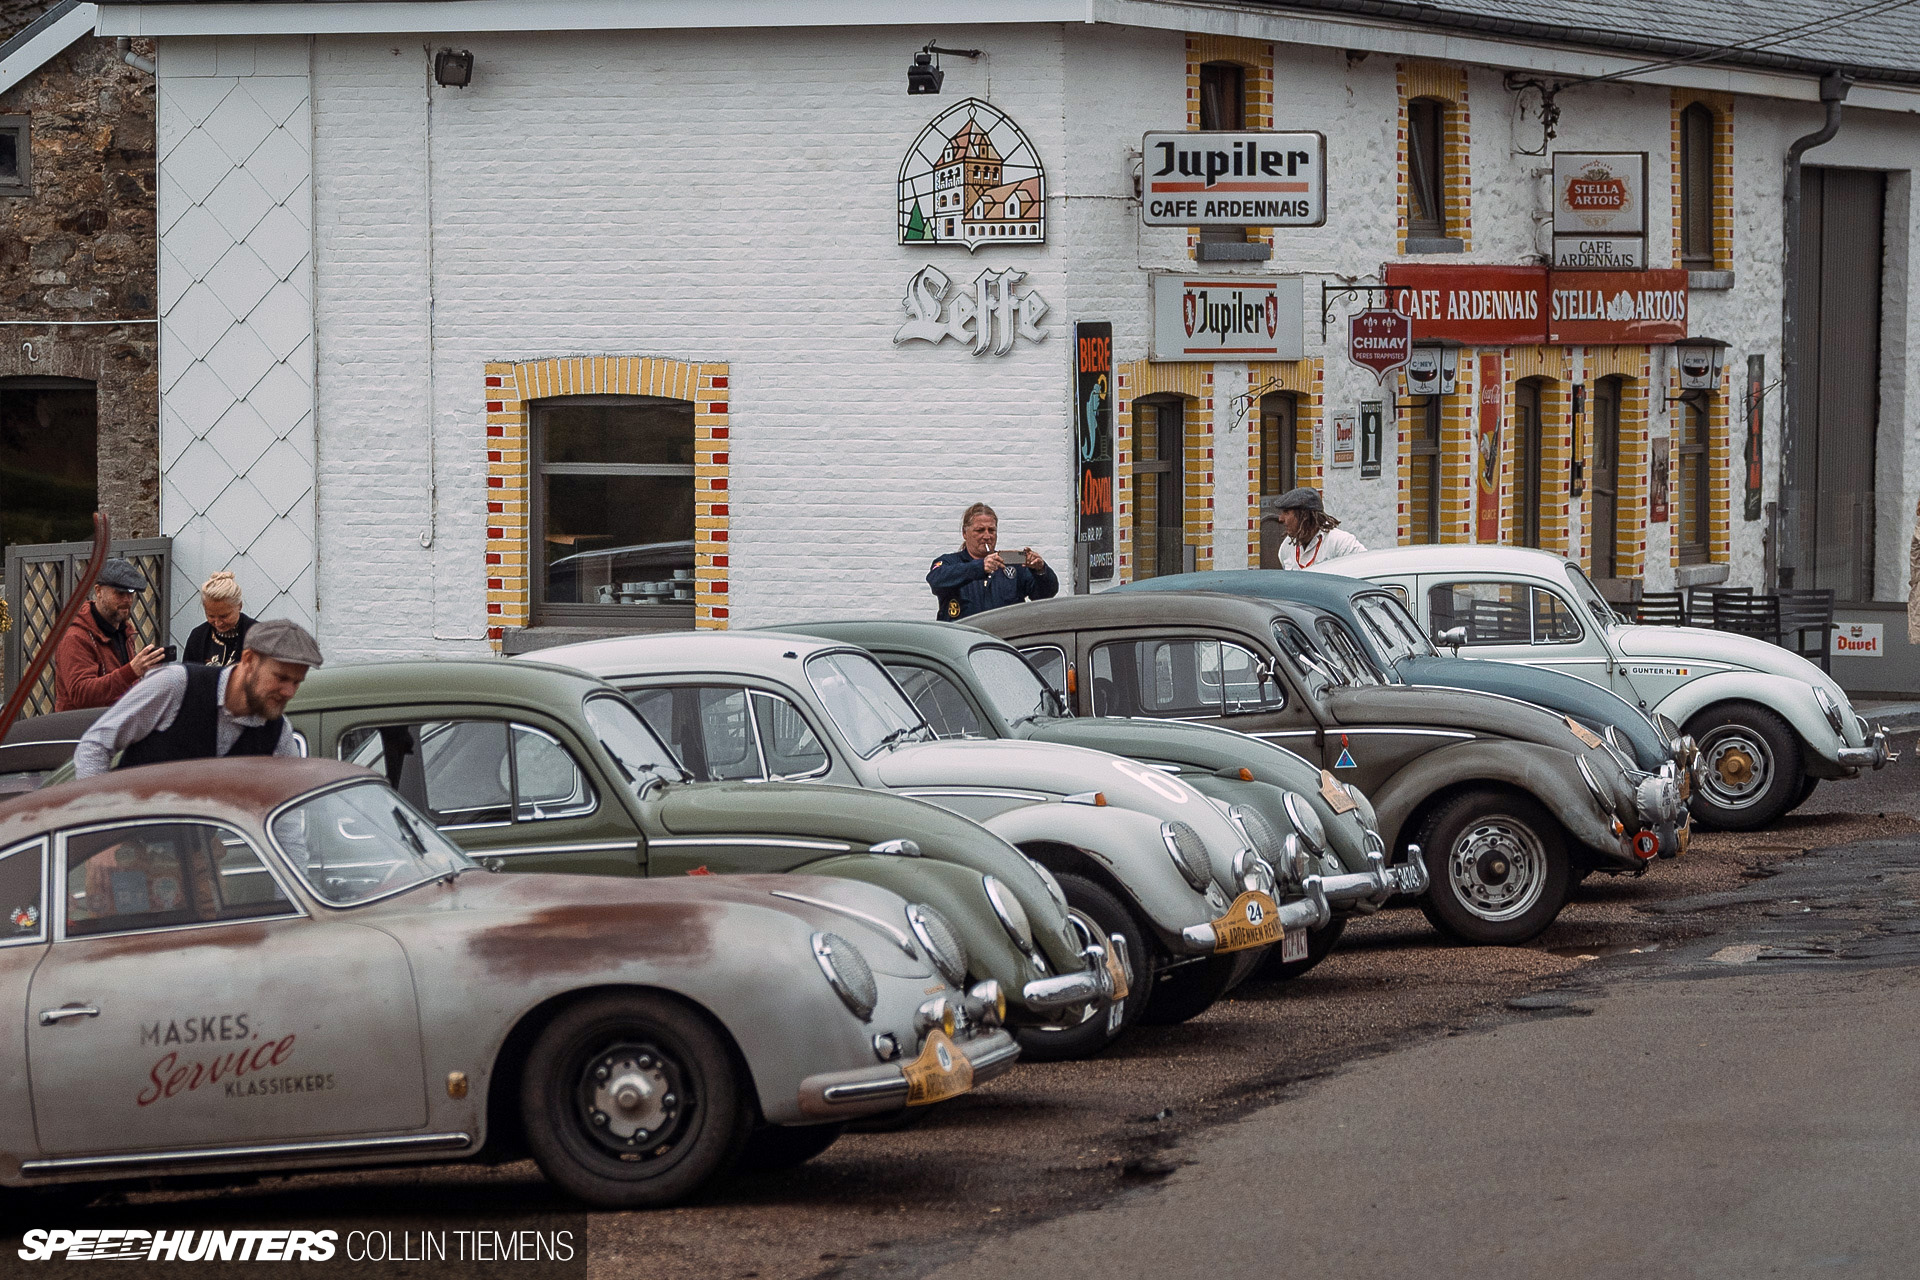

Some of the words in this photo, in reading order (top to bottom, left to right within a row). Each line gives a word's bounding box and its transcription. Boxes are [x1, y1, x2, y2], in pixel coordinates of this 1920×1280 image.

[1153, 142, 1309, 188] Jupiler
[1574, 184, 1619, 194] STELLA
[1204, 200, 1309, 218] ARDENNAIS
[1574, 195, 1620, 205] ARTOIS
[1579, 241, 1613, 254] CAFE
[1560, 254, 1634, 267] ARDENNAIS
[893, 264, 1050, 357] Leffe
[1399, 289, 1441, 320] CAFE
[1447, 289, 1539, 320] ARDENNAIS
[1552, 289, 1604, 321] STELLA
[1635, 289, 1686, 321] ARTOIS
[1197, 290, 1265, 345] Jupiler
[1353, 337, 1407, 349] CHIMAY
[1362, 404, 1382, 414] TOURIST
[1336, 422, 1353, 442] Duvel
[1090, 552, 1113, 568] RAPPISTES
[1837, 635, 1877, 651] Duvel
[1632, 667, 1664, 675] GUNTER
[1248, 903, 1263, 922] 24
[1229, 926, 1264, 949] ARDENNEN
[140, 1013, 249, 1046] MASKES
[137, 1033, 296, 1107] Service
[223, 1073, 336, 1099] KLASSIEKERS
